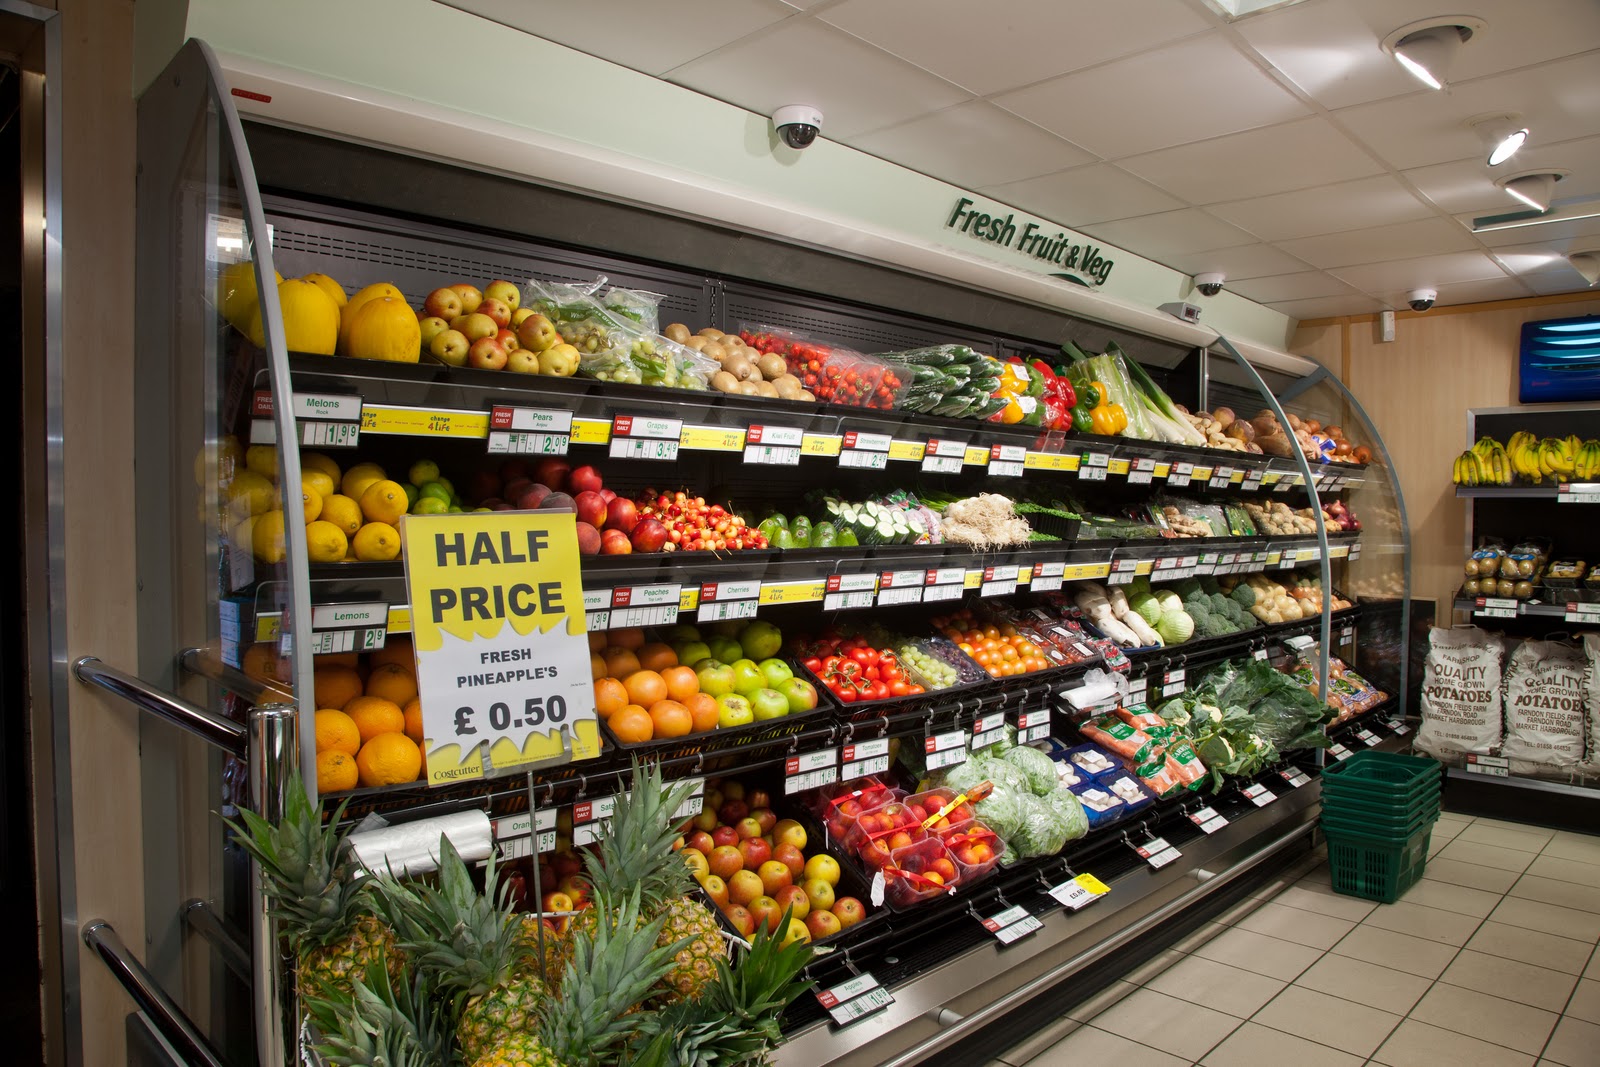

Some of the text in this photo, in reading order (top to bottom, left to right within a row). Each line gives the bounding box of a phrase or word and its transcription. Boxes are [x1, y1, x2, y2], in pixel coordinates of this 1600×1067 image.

[948, 197, 1115, 287] Fresh Fruit & Veg
[306, 398, 340, 409] Melons
[532, 412, 553, 421] Pears
[646, 421, 668, 430] Grapes
[329, 425, 357, 443] 1.99
[544, 436, 567, 452] 2.09
[434, 529, 549, 567] HALF
[430, 581, 566, 624] PRICE
[334, 612, 370, 620] Lemons
[480, 648, 532, 664] FRESH
[456, 666, 558, 688] PINEAPPLE'S
[1433, 663, 1487, 682] QUALITY
[1434, 678, 1455, 686] HOME
[1427, 686, 1492, 703] POTATOES
[1549, 688, 1581, 698] GROWN
[1454, 703, 1472, 712] FIELDS
[453, 694, 567, 736] £ 0.50
[1448, 716, 1486, 726] HARBOROUGH
[1518, 708, 1582, 722] FARNDON FIELDS FARM
[1526, 716, 1572, 728] FARNDON ROAD
[1516, 722, 1581, 736] MARKET HARBOROUGH
[862, 743, 882, 752] Tomatoes
[810, 754, 827, 762] Apples
[433, 764, 480, 781] Costcutter
[844, 980, 862, 991] Apples
